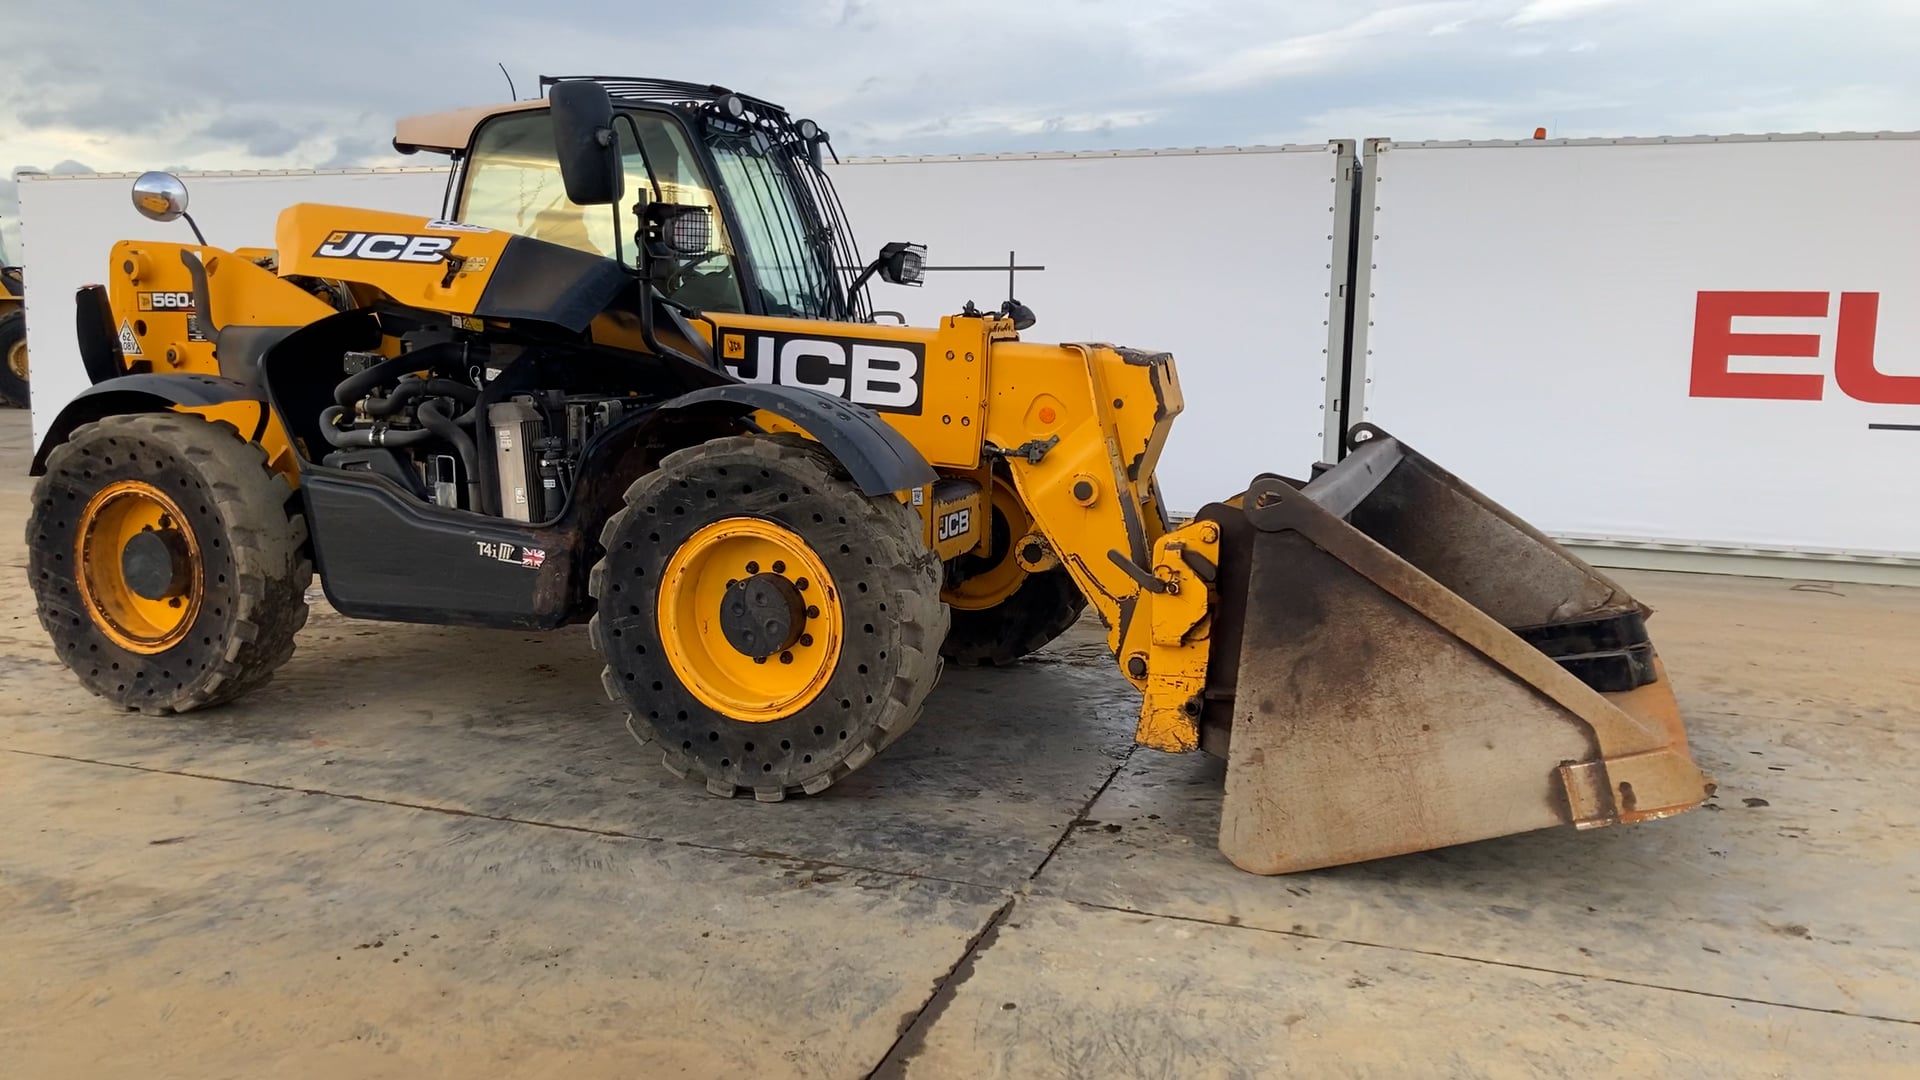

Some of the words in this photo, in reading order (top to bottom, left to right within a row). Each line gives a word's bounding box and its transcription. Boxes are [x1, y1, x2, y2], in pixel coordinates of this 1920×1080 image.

[319, 233, 452, 263] JCB
[152, 292, 196, 308] 560-
[1689, 290, 1920, 406] EU
[724, 336, 919, 408] JCB
[939, 509, 969, 540] JCB
